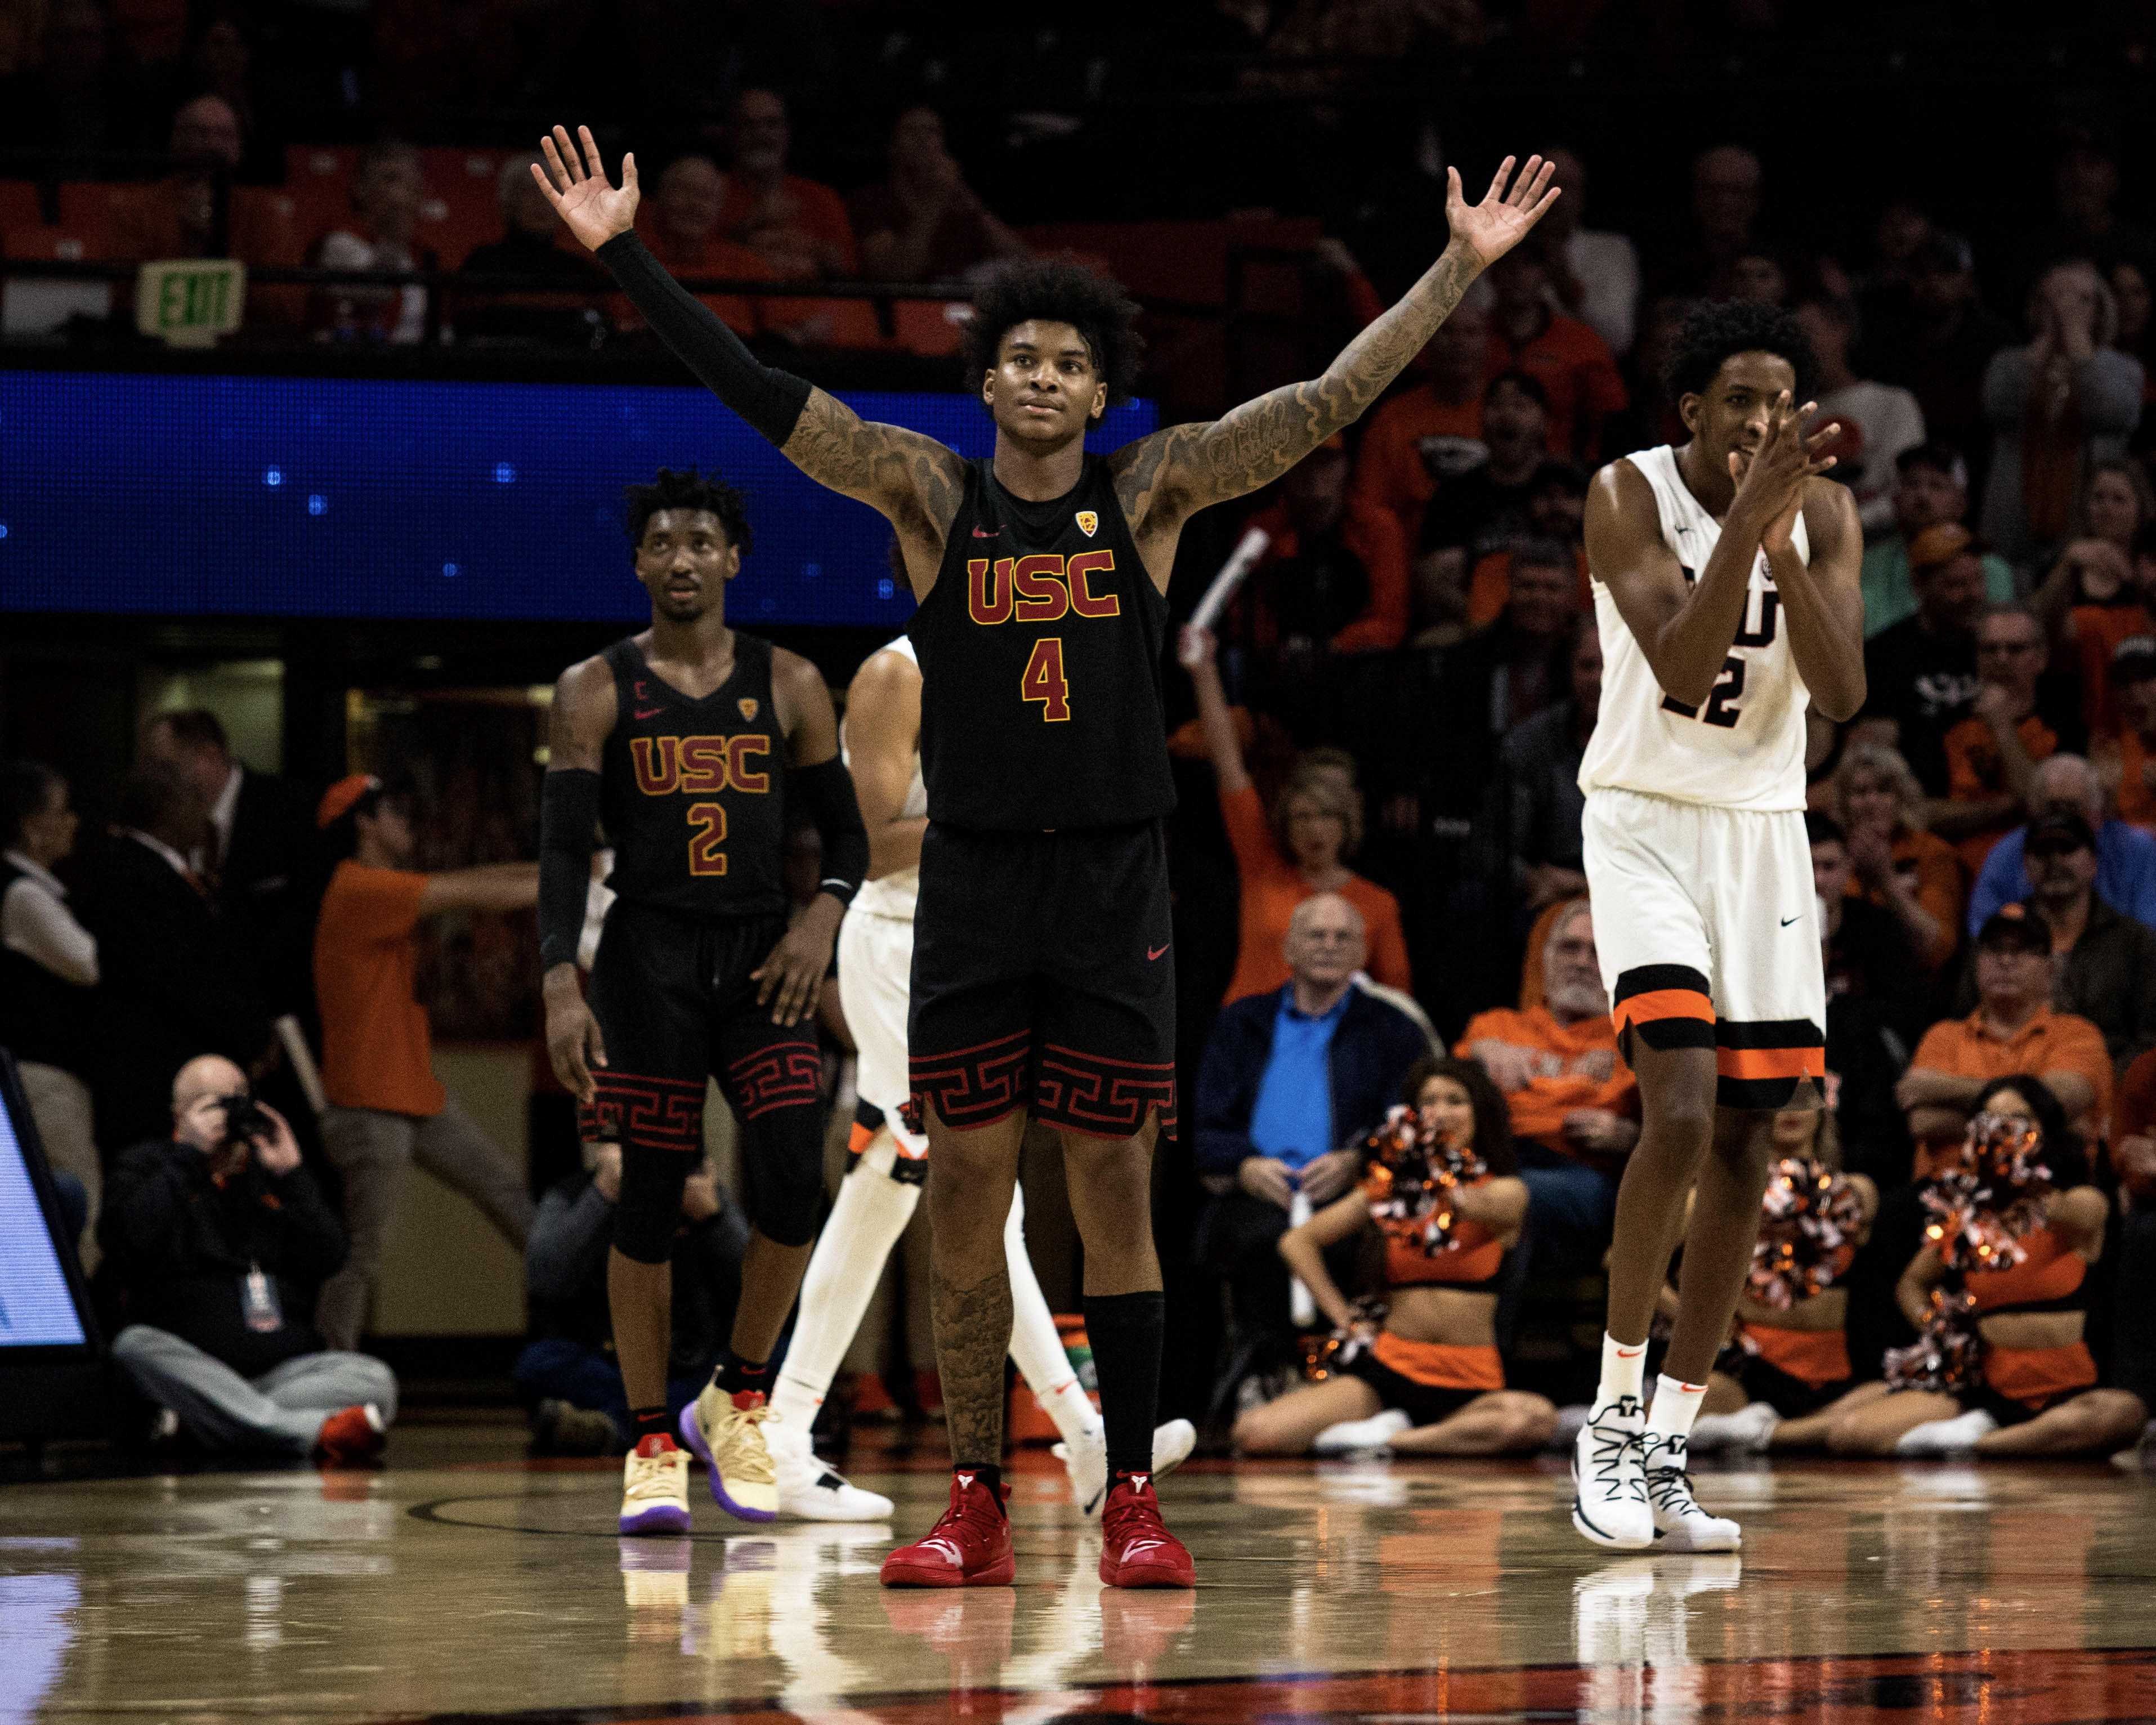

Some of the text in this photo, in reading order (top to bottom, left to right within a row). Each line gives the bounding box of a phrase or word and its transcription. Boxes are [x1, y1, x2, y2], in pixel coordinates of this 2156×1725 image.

[160, 272, 229, 328] EXIT
[968, 549, 1120, 625] USC
[634, 681, 648, 700] C
[1021, 638, 1070, 722] 4
[1661, 656, 1745, 728] 2
[629, 734, 771, 796] USC
[687, 802, 728, 876] 2
